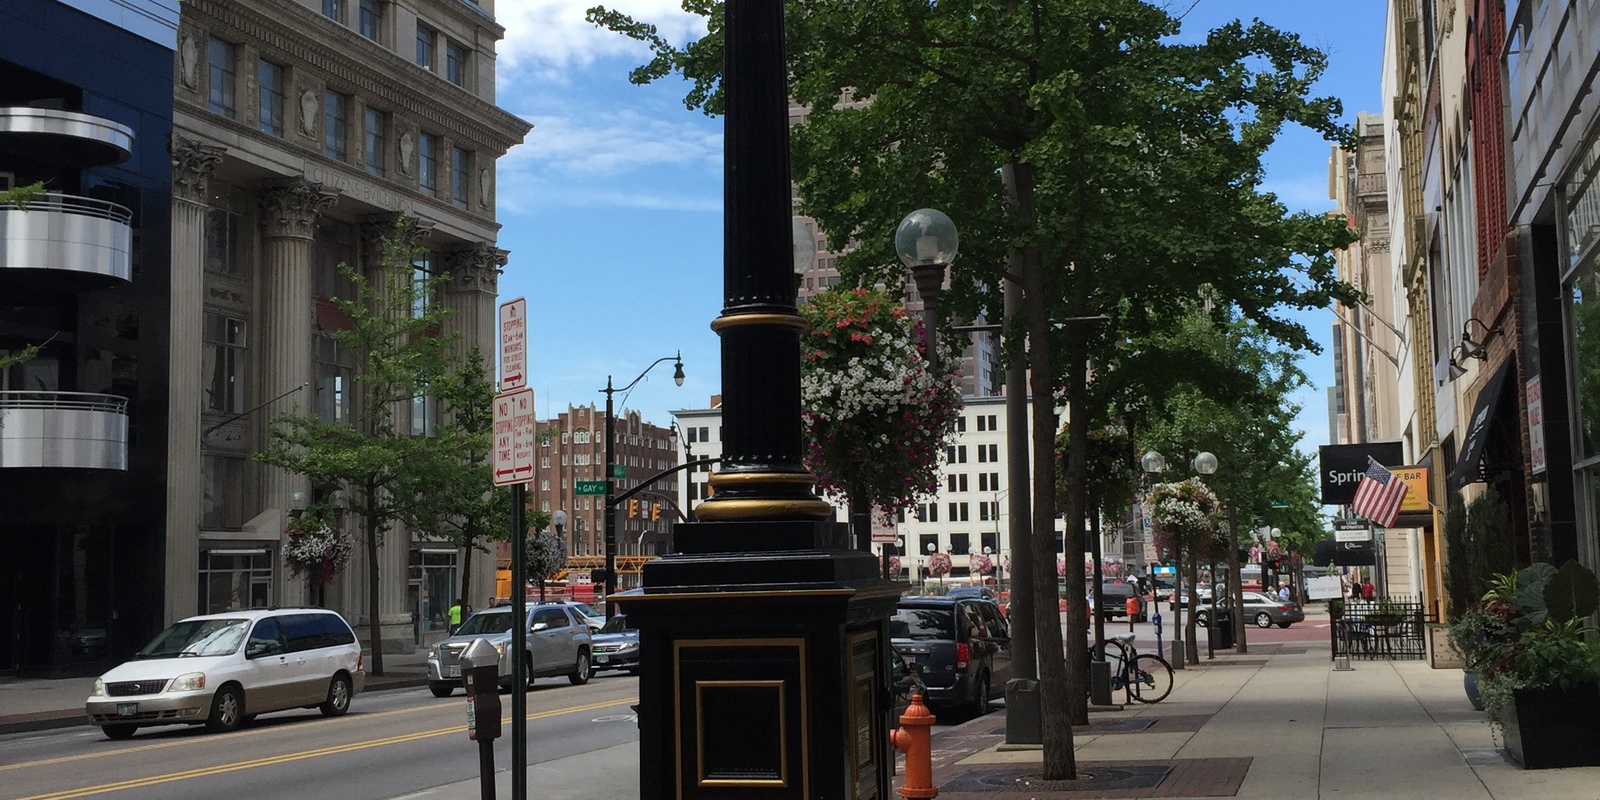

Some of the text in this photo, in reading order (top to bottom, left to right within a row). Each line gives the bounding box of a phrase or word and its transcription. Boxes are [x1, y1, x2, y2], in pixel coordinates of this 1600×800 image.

[509, 308, 516, 318] NO
[503, 318, 523, 332] STOPPING
[503, 352, 523, 365] FOR STREET
[505, 363, 522, 374] CLEANING
[499, 403, 508, 417] NO
[519, 398, 527, 410] NO
[496, 419, 513, 435] STOPPING
[515, 414, 533, 428] STOPPING
[499, 436, 509, 449] ANY
[498, 449, 511, 462] TIME
[1328, 469, 1366, 486] Sprin
[1404, 472, 1422, 481] BAR
[582, 484, 598, 492] GAY
